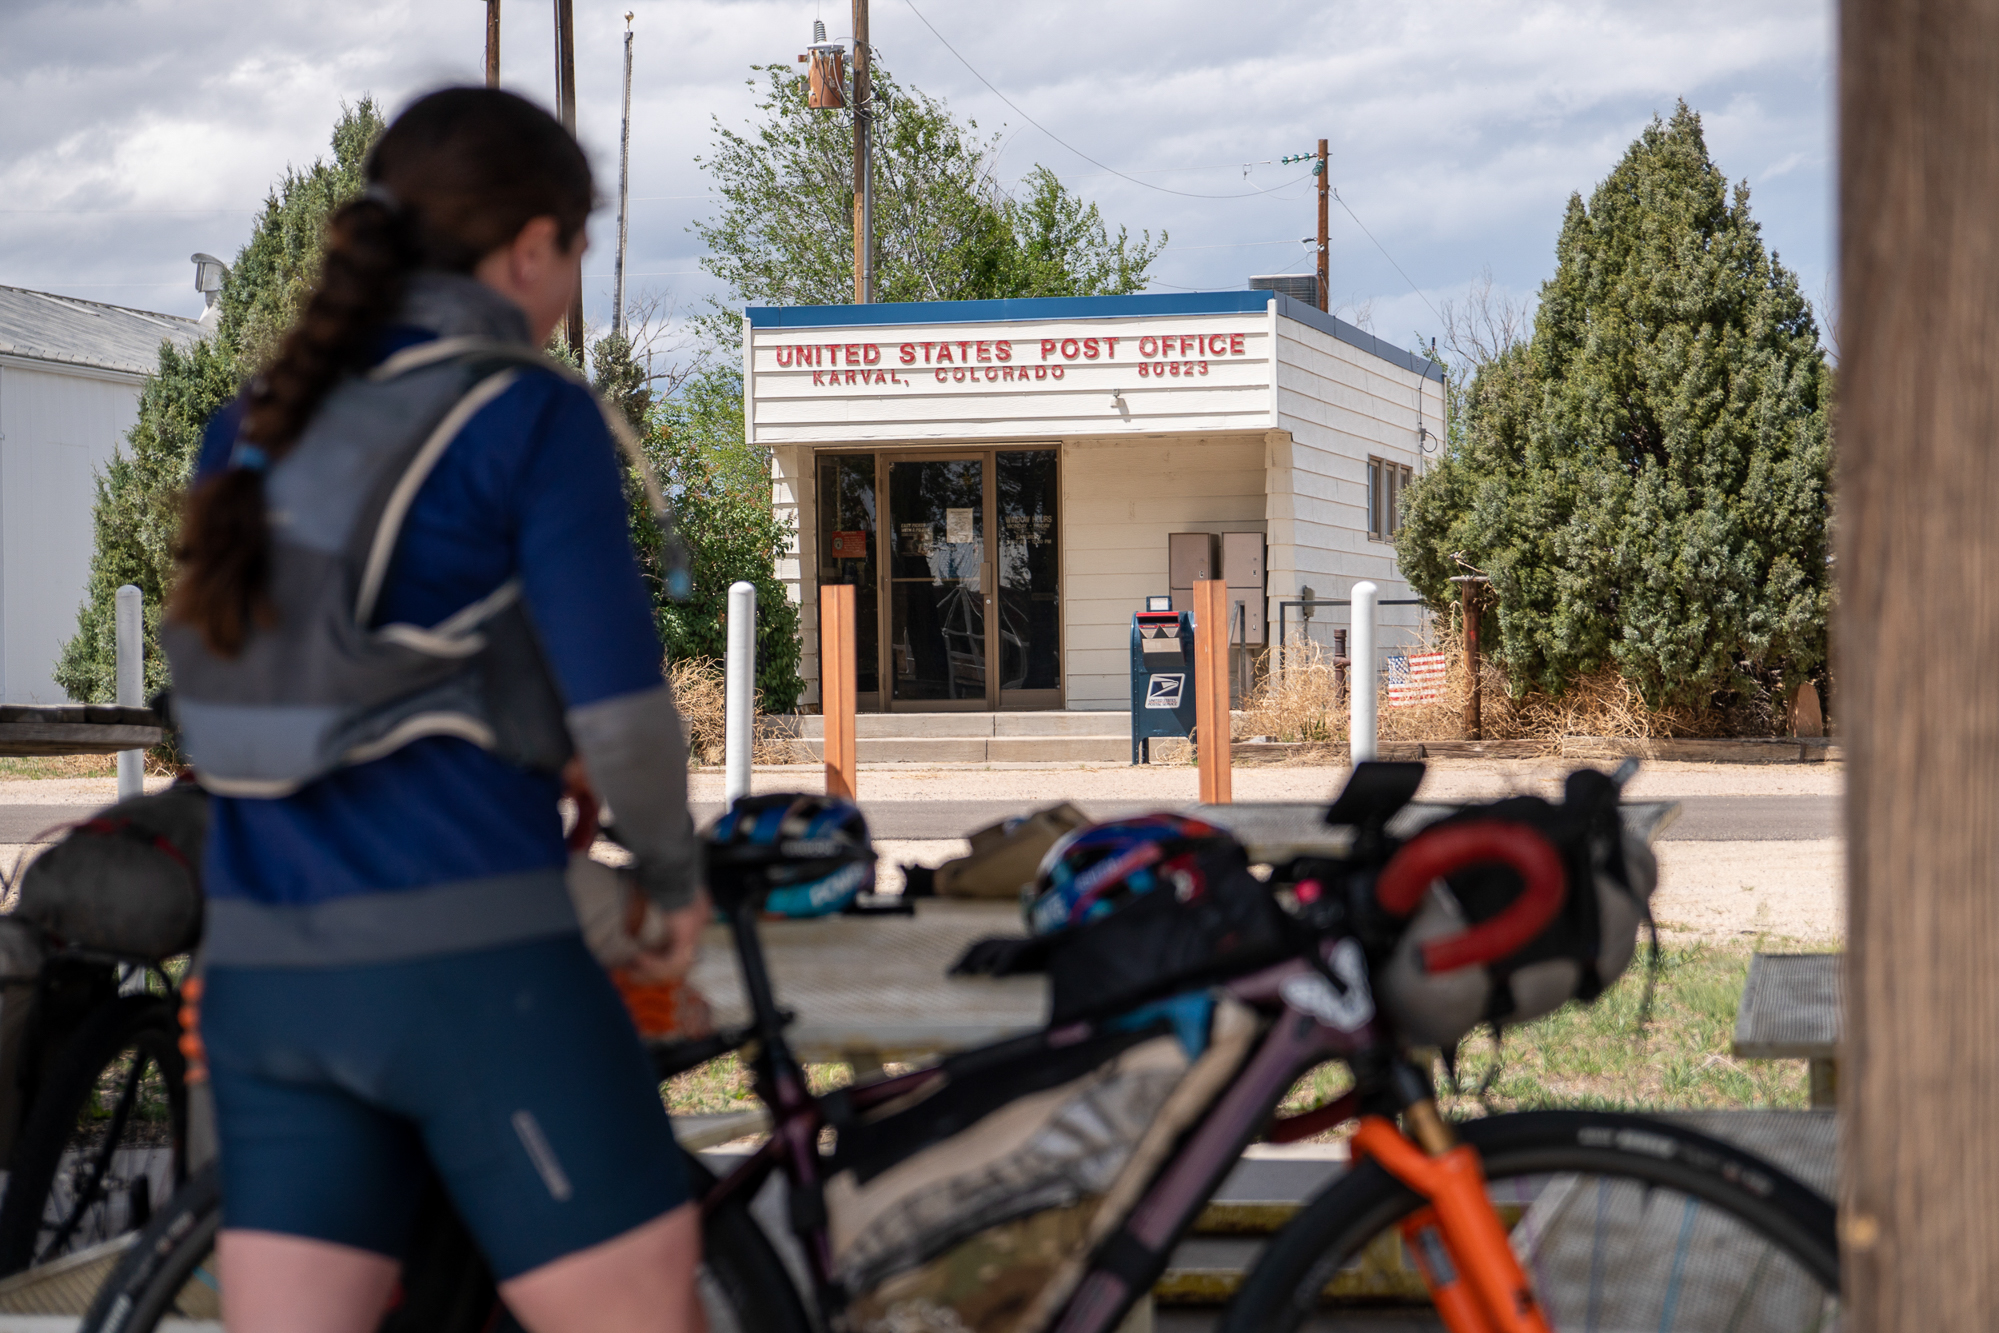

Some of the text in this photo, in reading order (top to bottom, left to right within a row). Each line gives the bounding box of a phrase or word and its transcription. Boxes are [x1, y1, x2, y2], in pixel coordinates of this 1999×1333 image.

[775, 333, 1246, 367] UNITED STATES POST OFFICE
[812, 360, 1208, 388] KARVAL, COLORADO 80823
